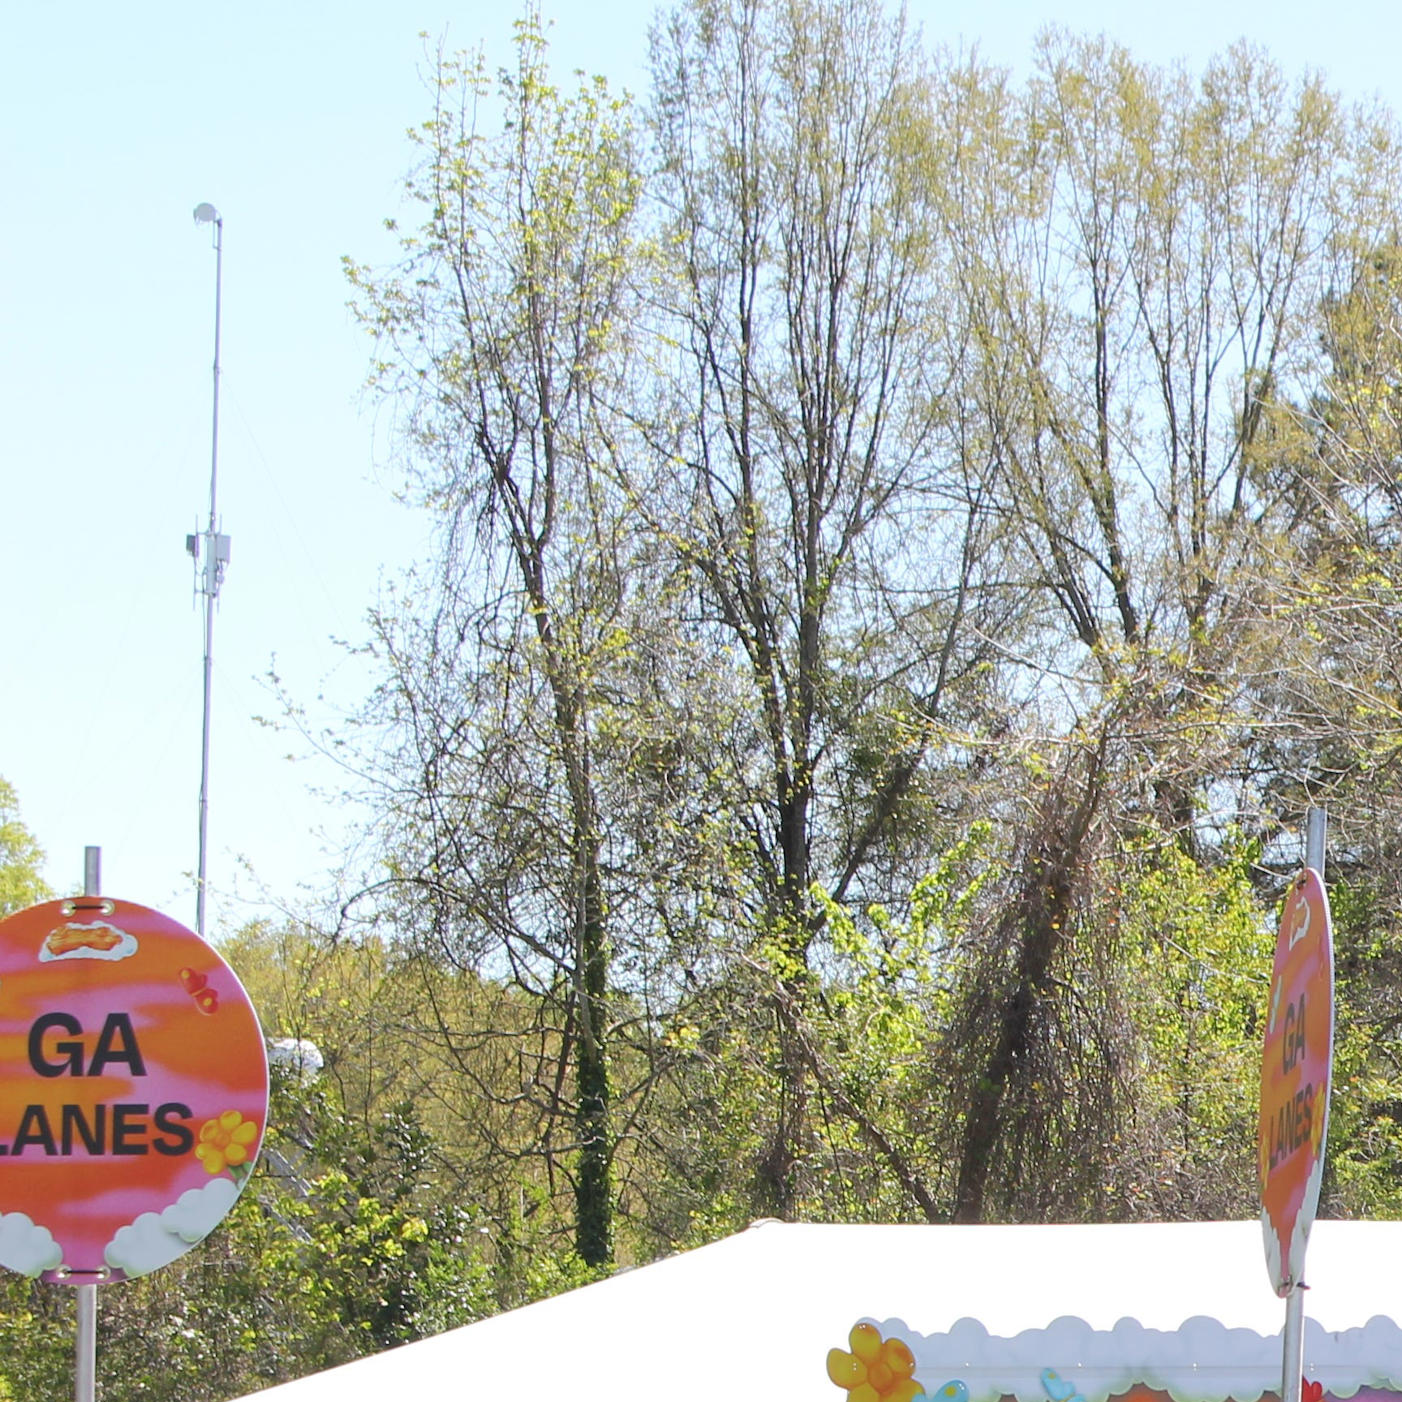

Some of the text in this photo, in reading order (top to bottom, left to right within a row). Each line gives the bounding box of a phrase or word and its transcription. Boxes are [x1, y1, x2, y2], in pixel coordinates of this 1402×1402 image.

[28, 1012, 147, 1078] GA
[1282, 992, 1306, 1075] GA
[1269, 1083, 1313, 1168] LANES
